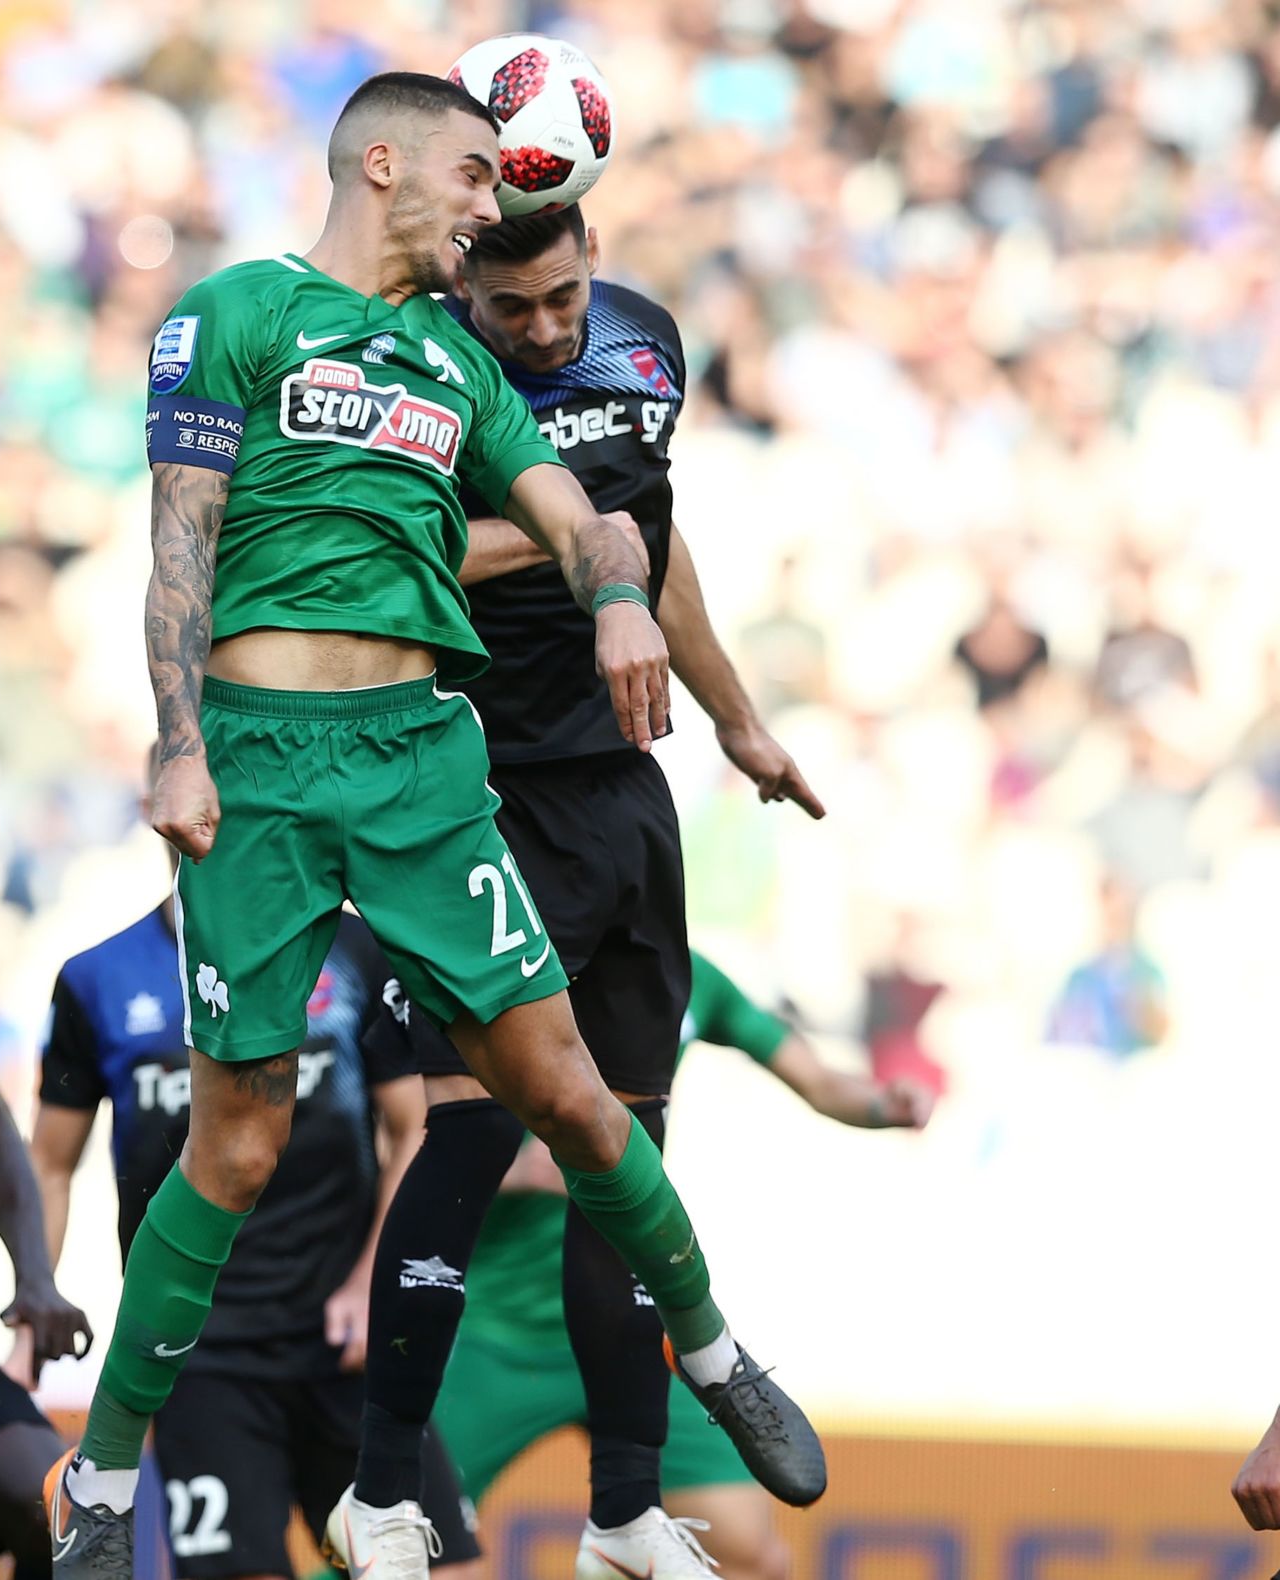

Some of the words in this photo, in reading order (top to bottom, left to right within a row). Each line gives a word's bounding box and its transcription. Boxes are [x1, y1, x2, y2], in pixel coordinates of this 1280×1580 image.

[312, 367, 357, 388] pame
[173, 411, 195, 423] NO
[197, 414, 215, 426] TO
[538, 401, 671, 450] pbet.gr
[197, 434, 240, 457] RESPEC
[468, 851, 542, 957] 21
